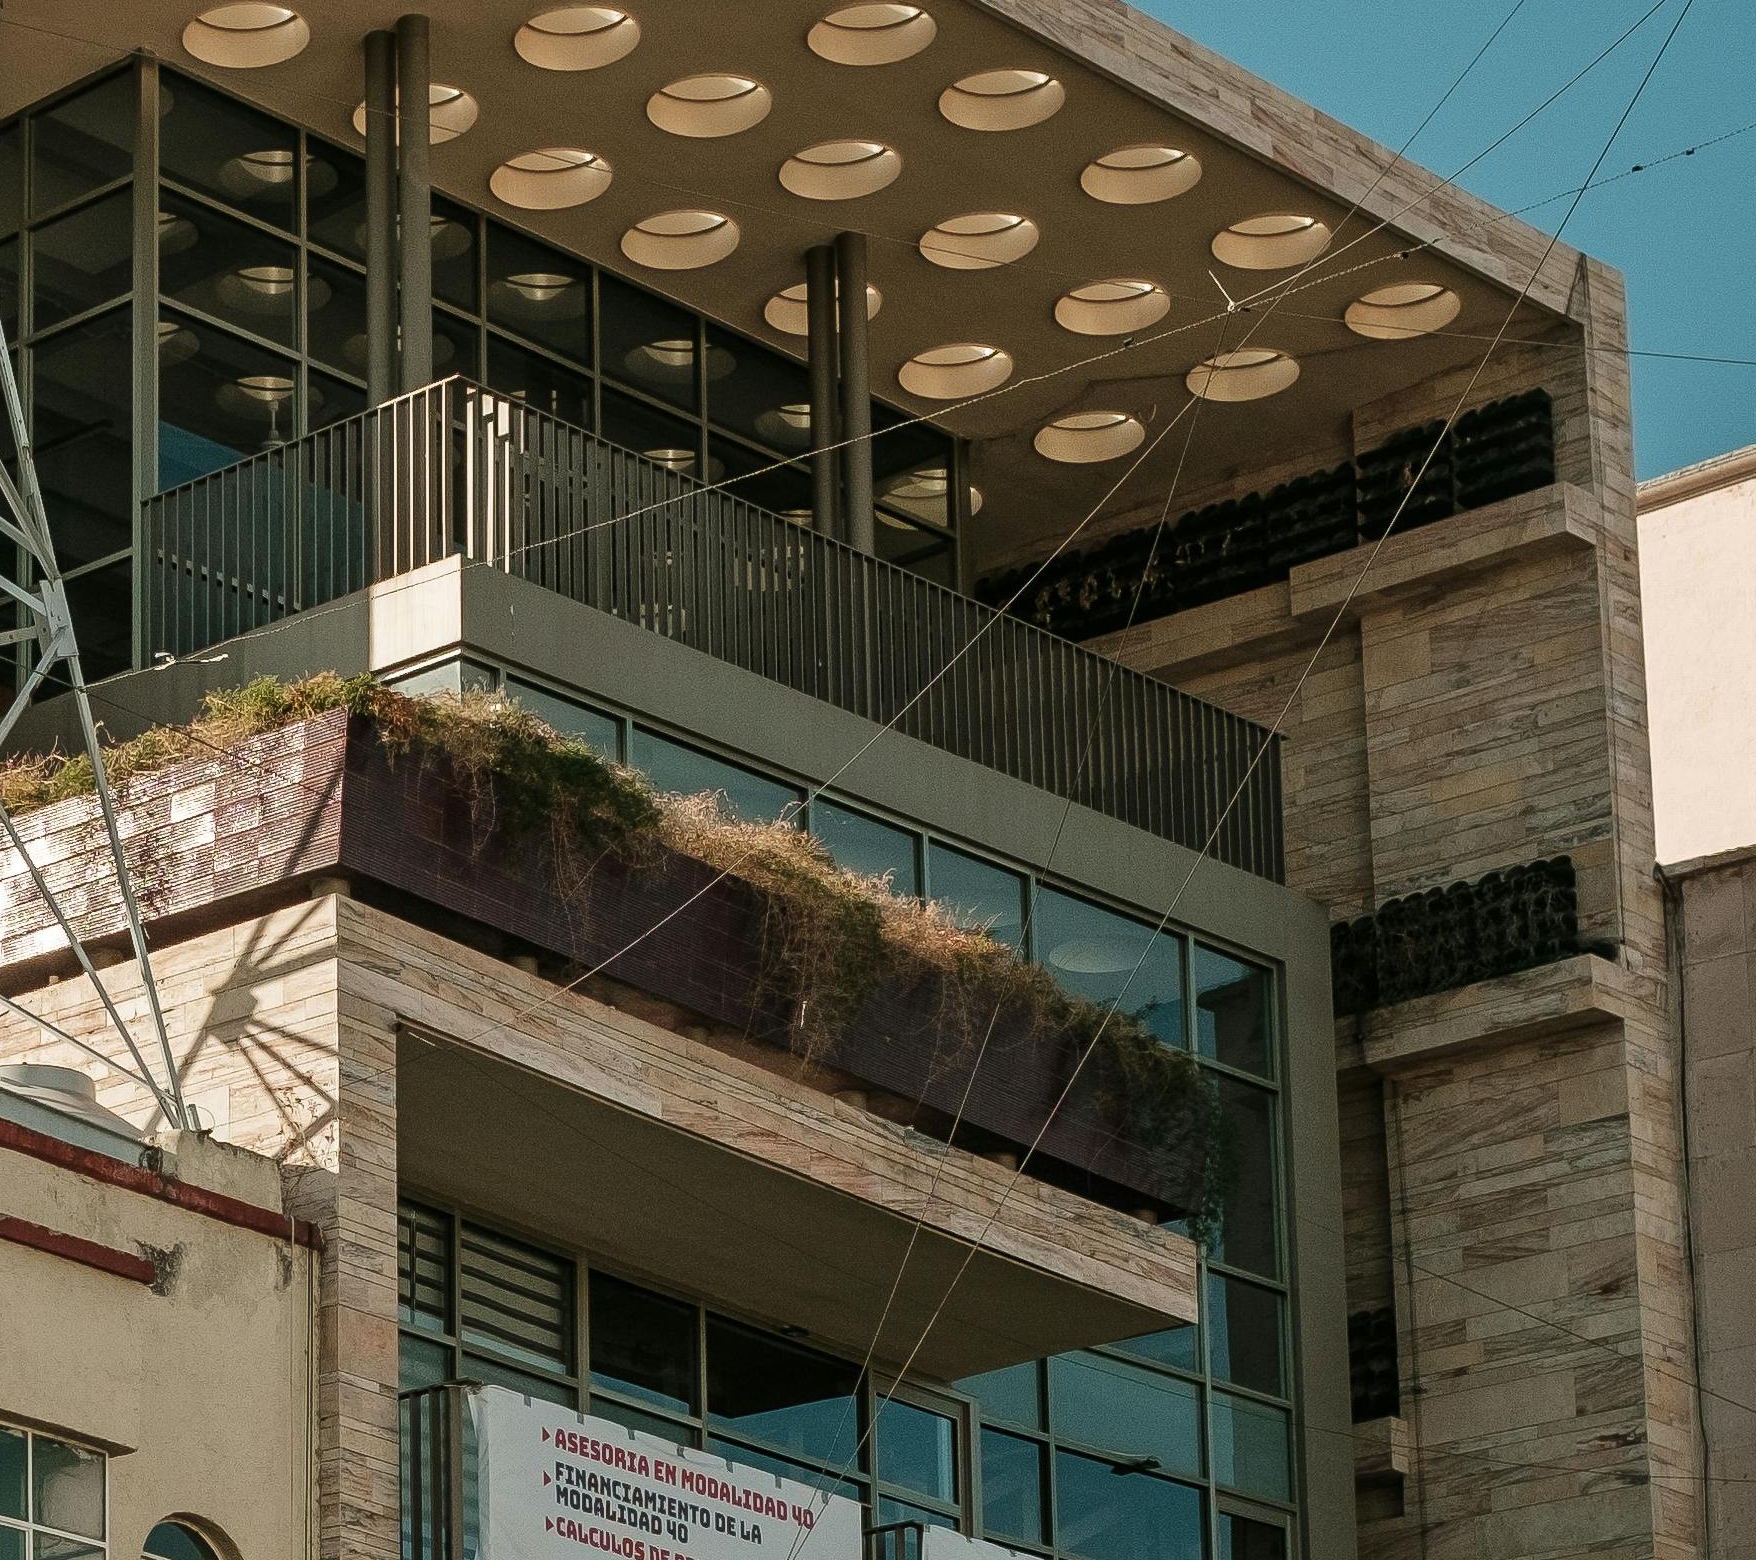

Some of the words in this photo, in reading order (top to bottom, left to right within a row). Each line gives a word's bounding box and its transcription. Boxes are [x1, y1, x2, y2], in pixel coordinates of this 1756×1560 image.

[554, 1427, 650, 1477] ASESORIA
[654, 1460, 678, 1485] EN
[681, 1470, 791, 1521] MODALIDAD
[793, 1502, 815, 1531] 40
[554, 1460, 711, 1528] FINANCIAMIENTO
[715, 1511, 738, 1537] DE
[740, 1517, 762, 1545] LA
[555, 1485, 662, 1536] MODALIDAD
[667, 1520, 688, 1544] 40
